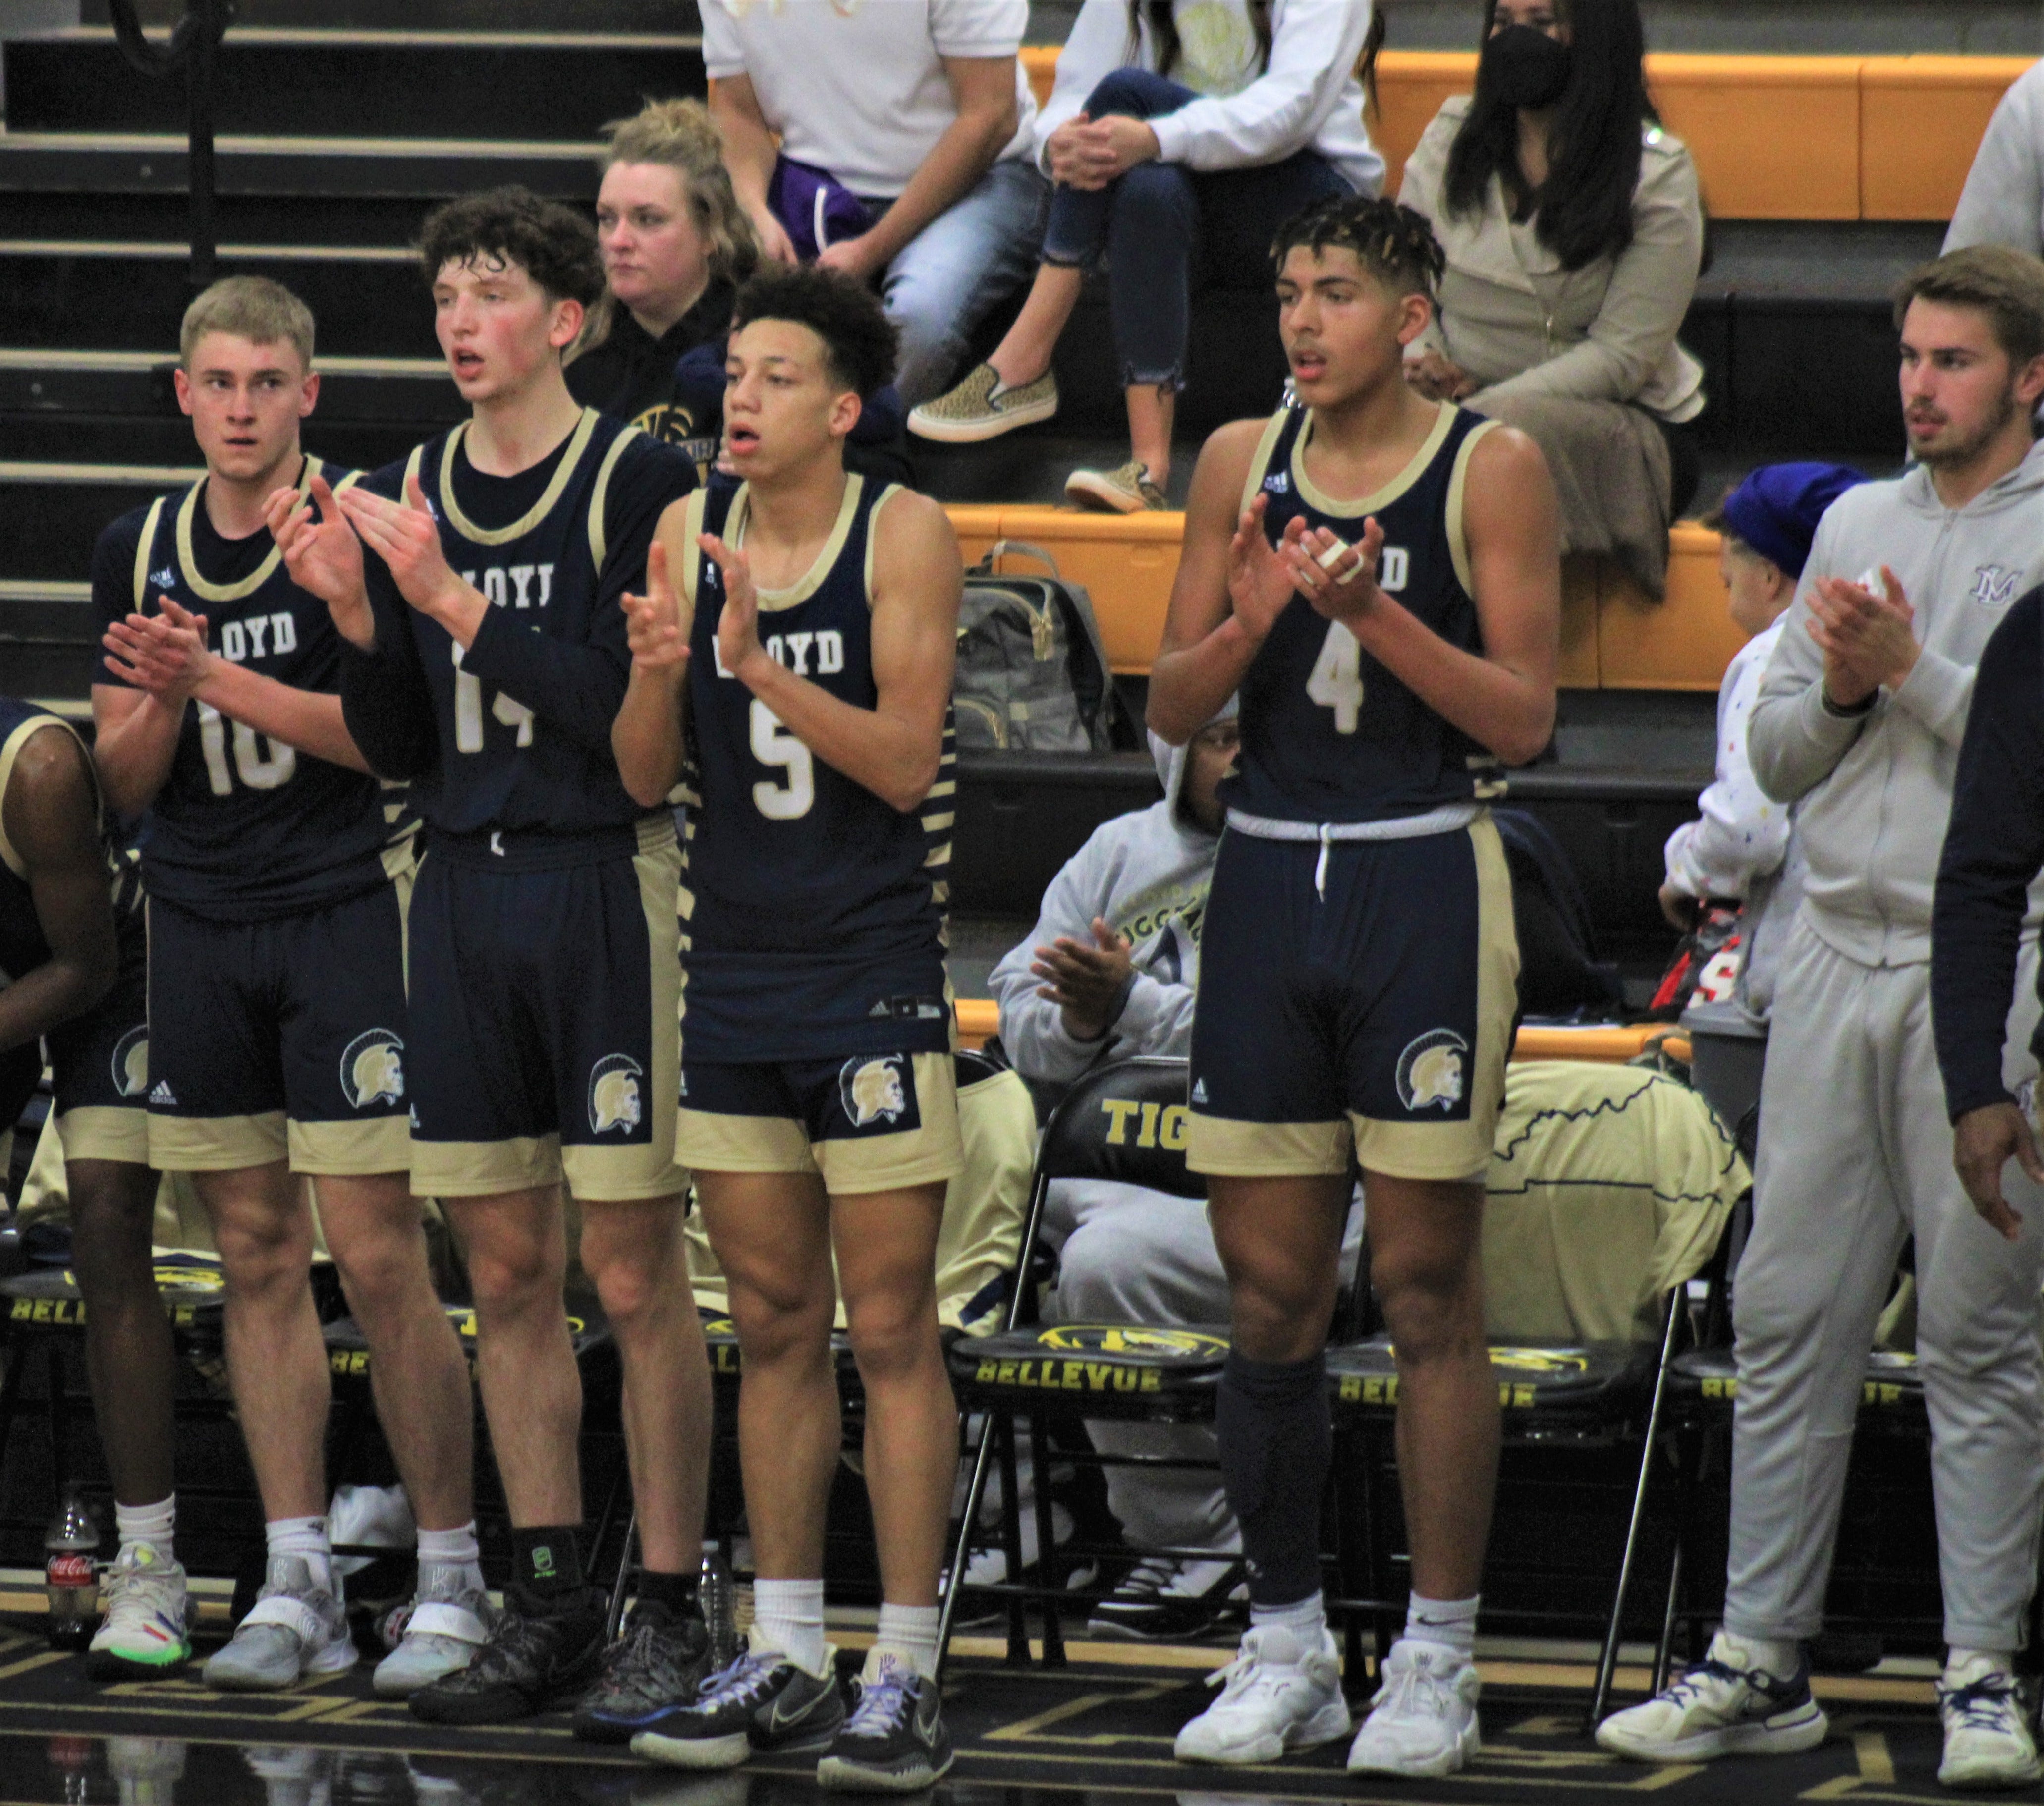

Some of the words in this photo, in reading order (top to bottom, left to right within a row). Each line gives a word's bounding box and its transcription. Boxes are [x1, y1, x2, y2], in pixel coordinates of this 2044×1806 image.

[210, 612, 297, 663] OYD
[1306, 619, 1364, 734] 4
[749, 698, 815, 821] 5
[1102, 1098, 1189, 1151] TIG
[975, 1359, 1162, 1392] BELLEVUE
